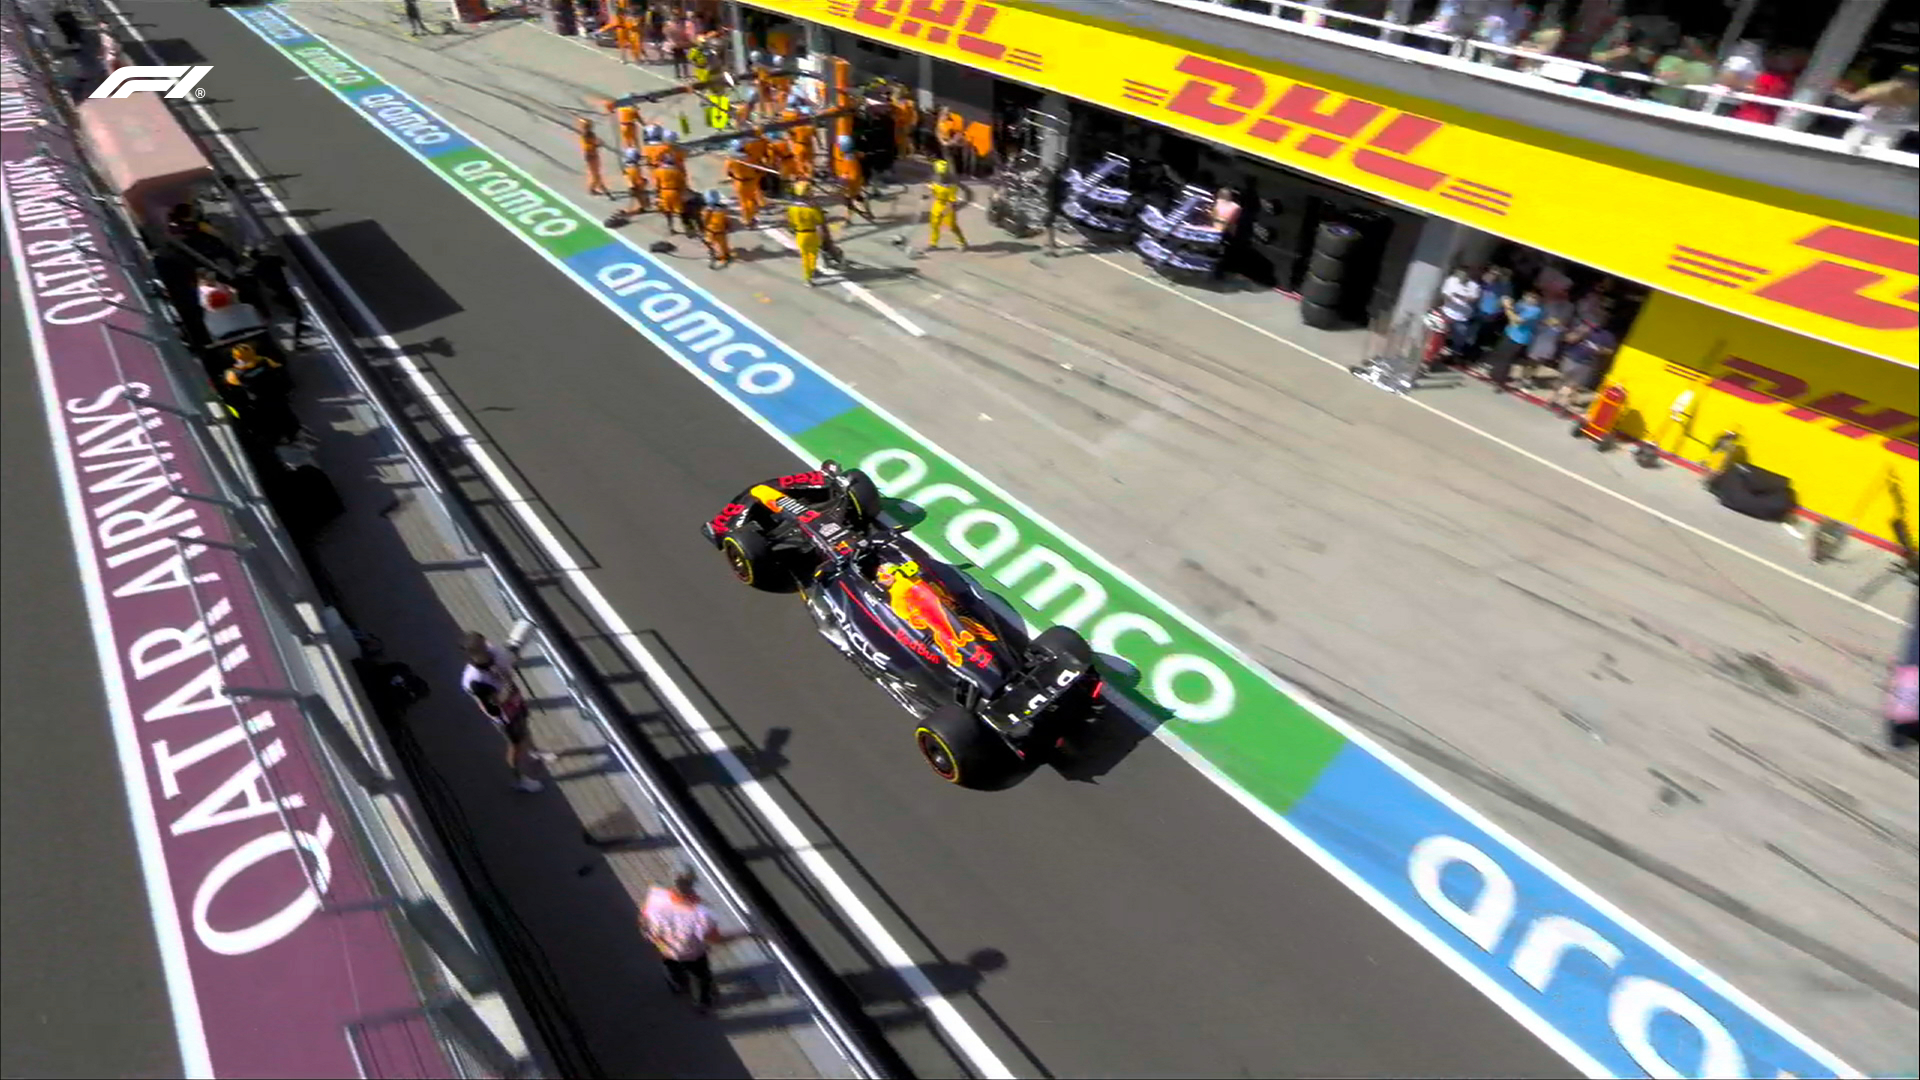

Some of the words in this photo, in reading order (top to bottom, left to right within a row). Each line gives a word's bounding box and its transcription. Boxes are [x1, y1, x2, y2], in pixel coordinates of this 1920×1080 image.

[361, 93, 450, 144] aramco
[1166, 55, 1447, 191] DHL
[452, 159, 578, 238] aramco
[27, 232, 125, 325] QATAR
[595, 261, 796, 395] aramco
[66, 381, 221, 599] AIRWAYS
[858, 448, 1236, 723] aramco
[129, 597, 333, 955] QATAR
[1407, 834, 1797, 1080] aro
